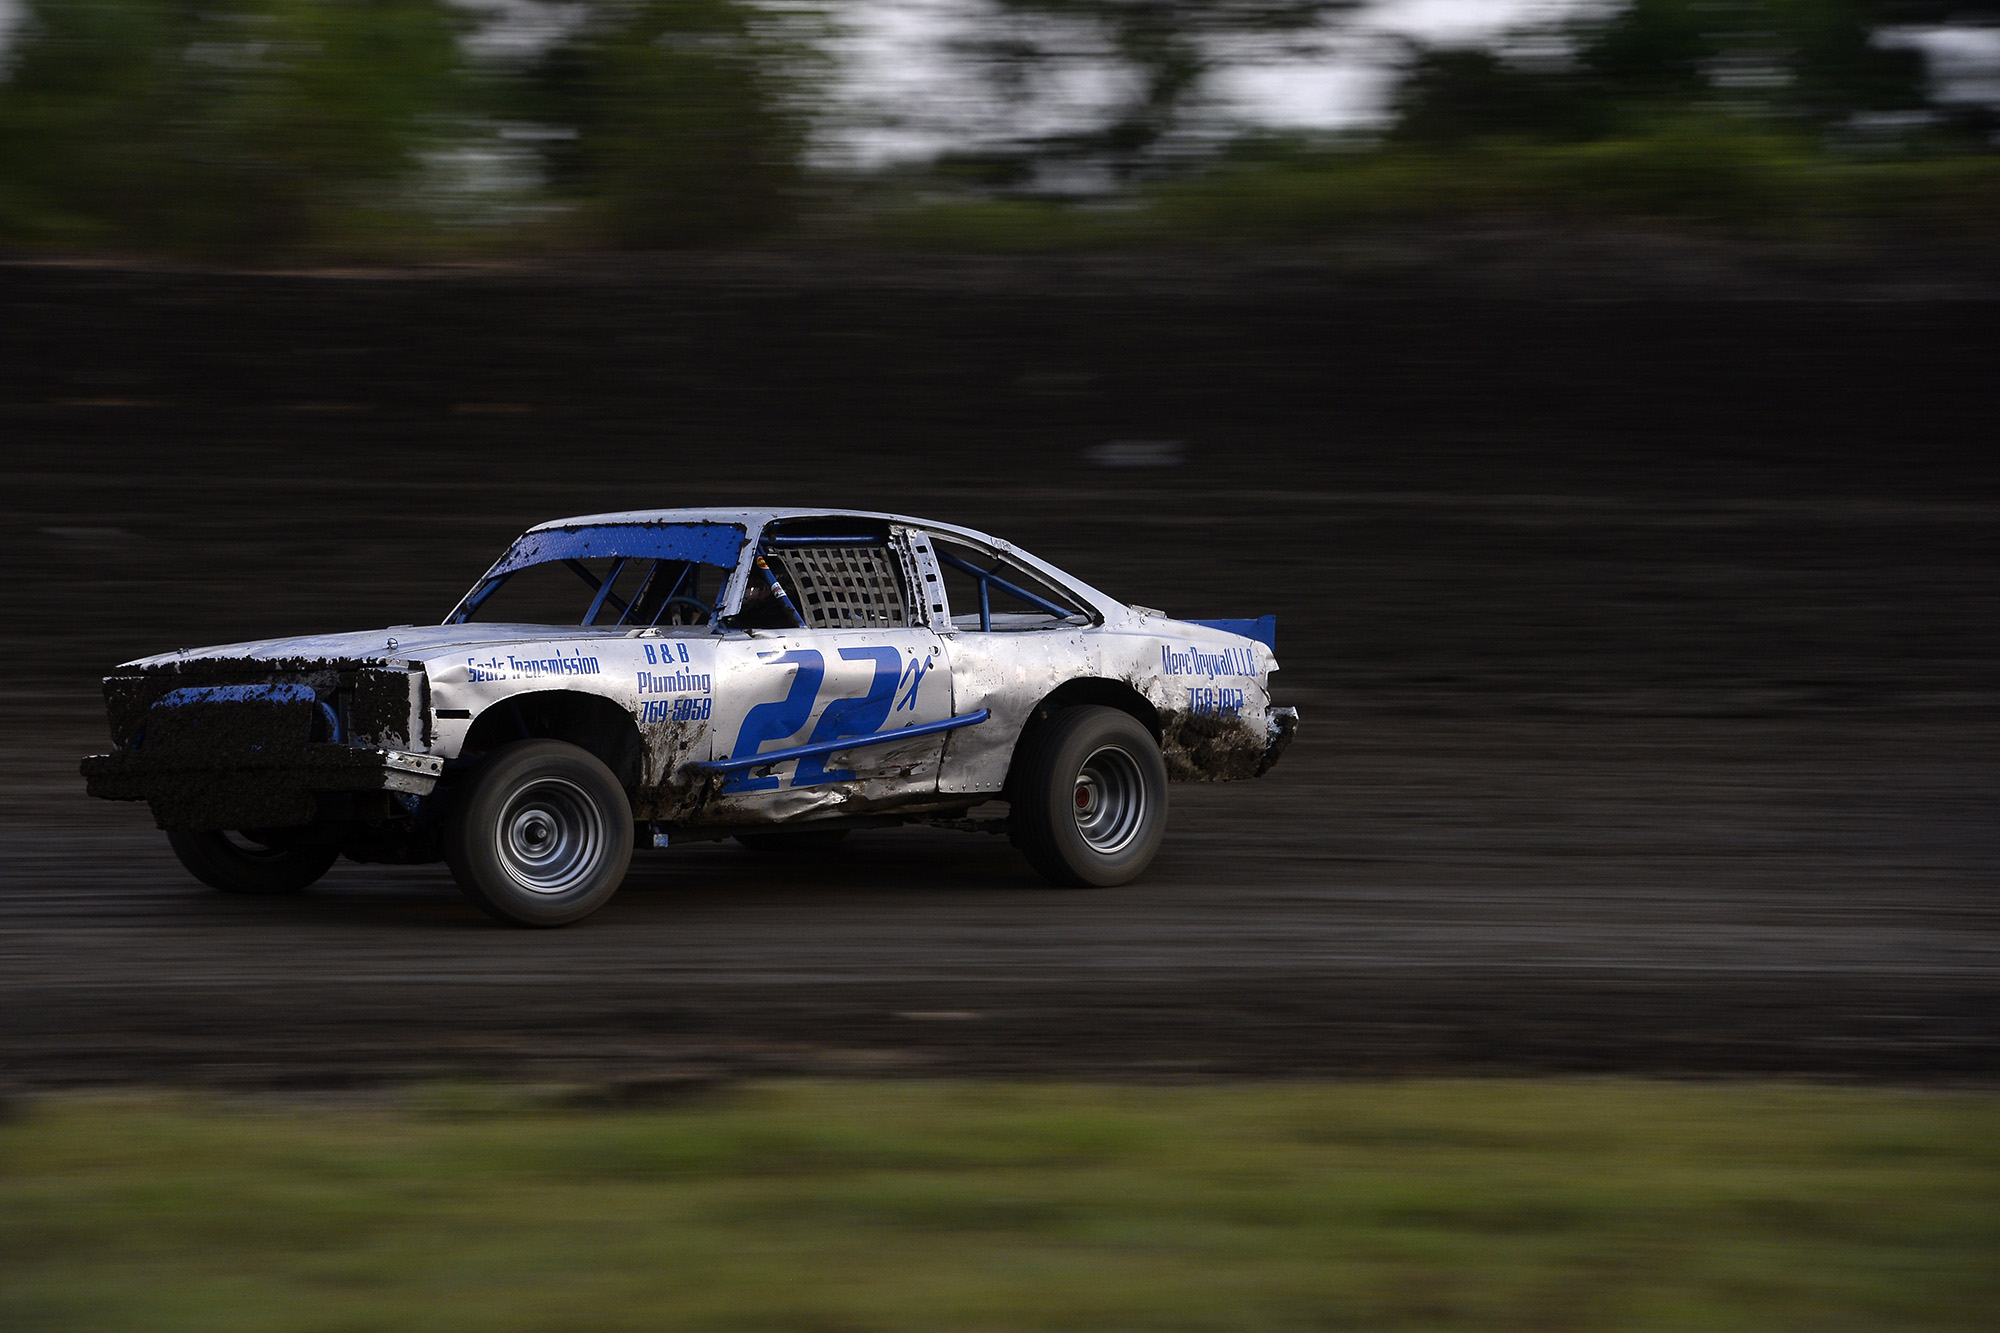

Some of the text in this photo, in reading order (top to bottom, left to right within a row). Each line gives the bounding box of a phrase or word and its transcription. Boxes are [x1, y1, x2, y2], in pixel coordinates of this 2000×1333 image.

[467, 647, 601, 683] Seals Transmission
[644, 642, 690, 665] B & B
[1161, 645, 1192, 676] Merc
[1190, 647, 1235, 681] Drywall
[637, 666, 711, 694] Plumbing
[640, 698, 712, 724] 769-5858
